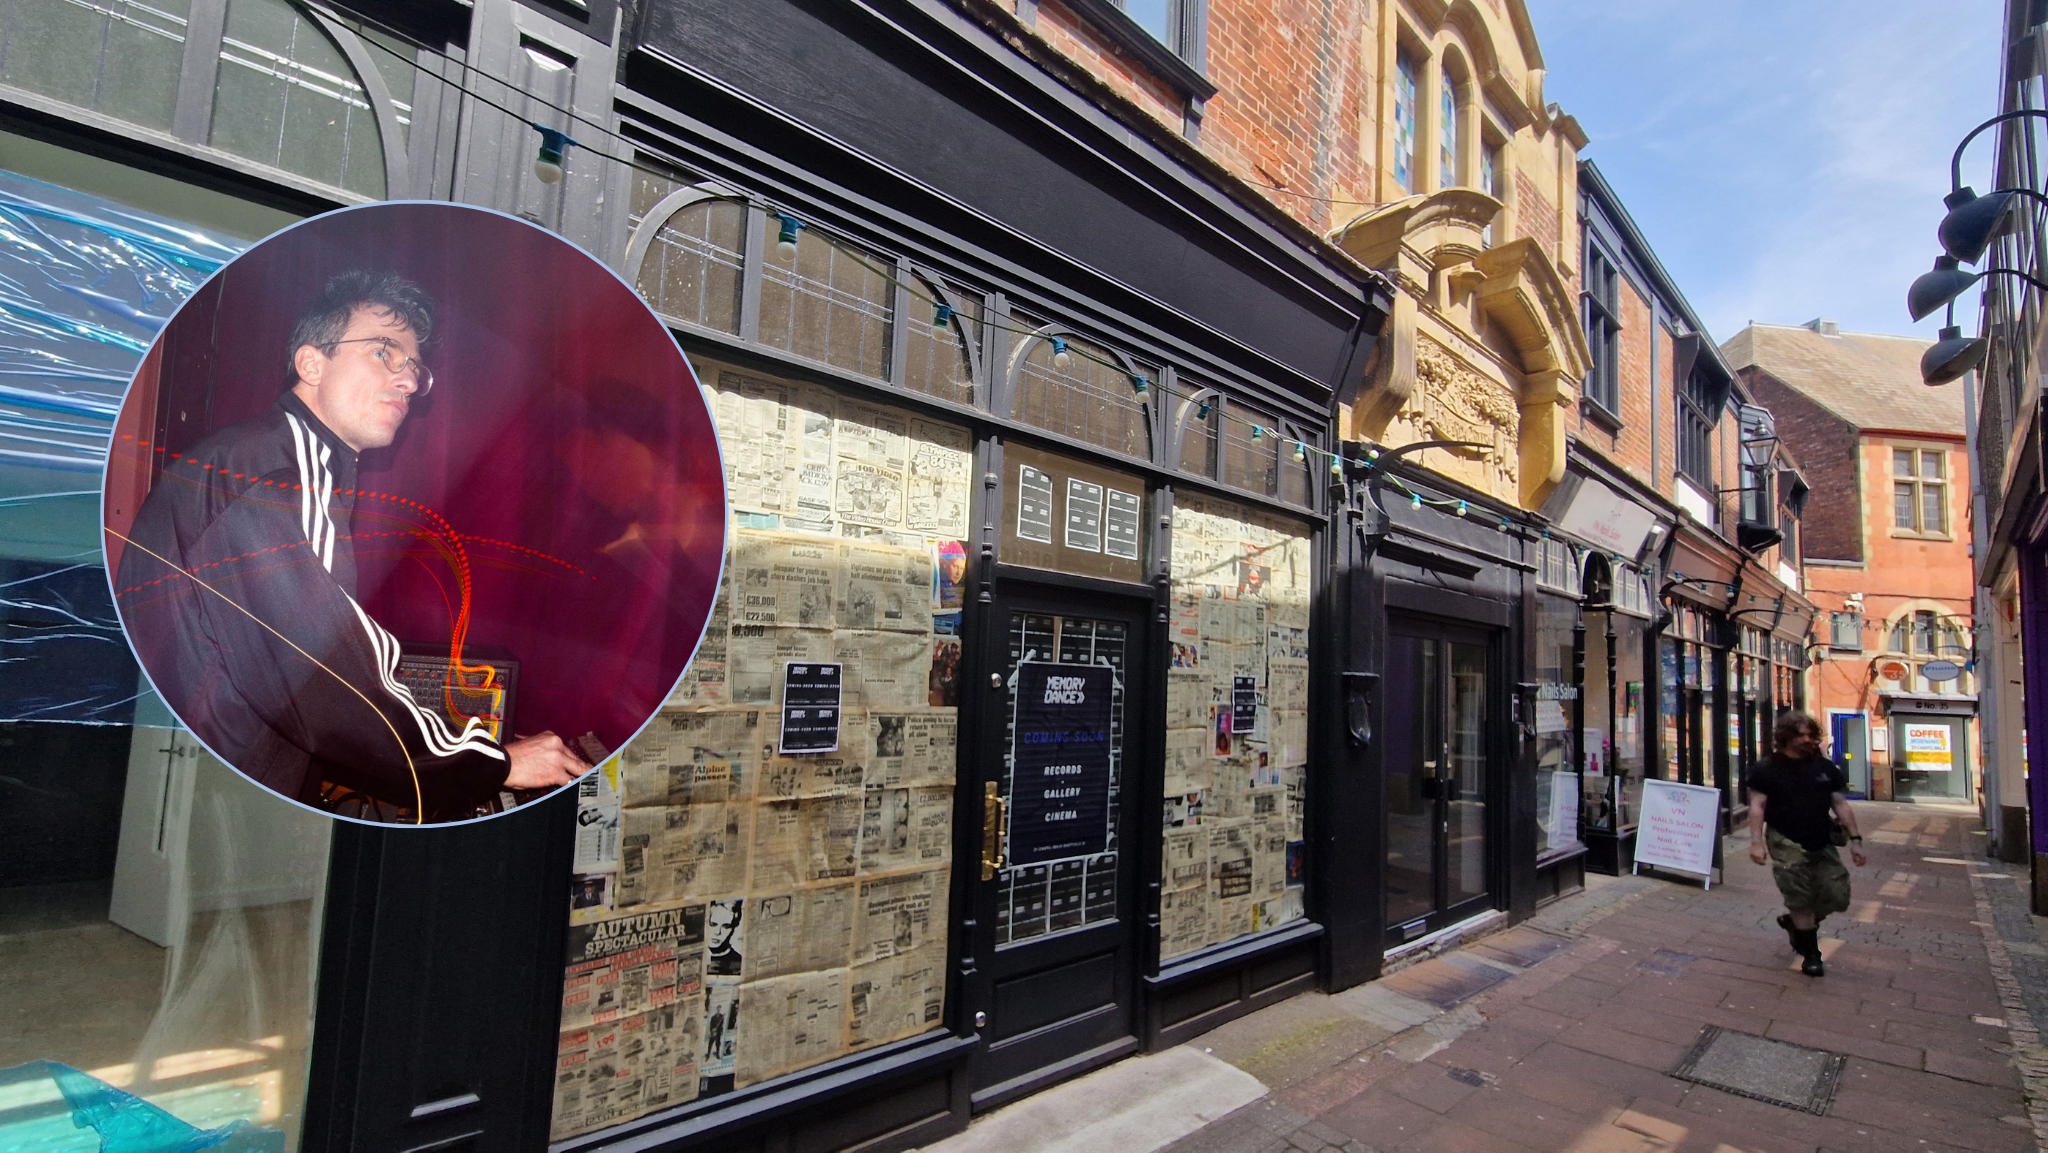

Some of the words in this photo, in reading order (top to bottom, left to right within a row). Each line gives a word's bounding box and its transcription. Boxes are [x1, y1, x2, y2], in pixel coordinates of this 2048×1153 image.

[920, 443, 960, 461] OLYMPICS
[929, 455, 946, 469] 84
[858, 464, 875, 473] FOR
[876, 466, 899, 482] VIDEO
[773, 564, 796, 573] Despair
[805, 567, 820, 576] youth
[850, 563, 876, 573] Vigilantes
[882, 567, 898, 575] patrol
[770, 573, 785, 581] store
[786, 574, 807, 583] dashes
[807, 576, 816, 584] job
[817, 577, 830, 586] hope
[850, 571, 860, 580] halt
[861, 572, 884, 582] allotment
[884, 574, 902, 585] raiders
[1046, 676, 1086, 691] MEMORY
[1542, 683, 1559, 700] Nails
[1560, 683, 1578, 700] Salon
[1939, 702, 1949, 710] 35
[907, 716, 922, 724] Police
[1024, 732, 1070, 745] COMING
[1074, 731, 1105, 743] SOON
[1910, 729, 1944, 739] COFFEE
[695, 765, 726, 775] Alpine
[1044, 765, 1082, 776] RECORDS
[694, 773, 727, 783] passes
[1044, 787, 1081, 799] GALLERY
[1045, 810, 1077, 822] CINEMA
[1671, 807, 1686, 816] VN
[1651, 816, 1674, 825] NAILS
[1676, 819, 1704, 830] SALON
[1652, 826, 1700, 839] Professional
[1657, 836, 1673, 844] Nail
[1674, 839, 1692, 848] Care
[592, 909, 683, 941] AUTUMN
[585, 924, 686, 956] SPECTACULAR
[566, 975, 591, 990] FREE
[597, 970, 620, 986] FREE
[565, 990, 590, 1006] FREE
[594, 1009, 617, 1025] FREE
[561, 1052, 586, 1067] FREE
